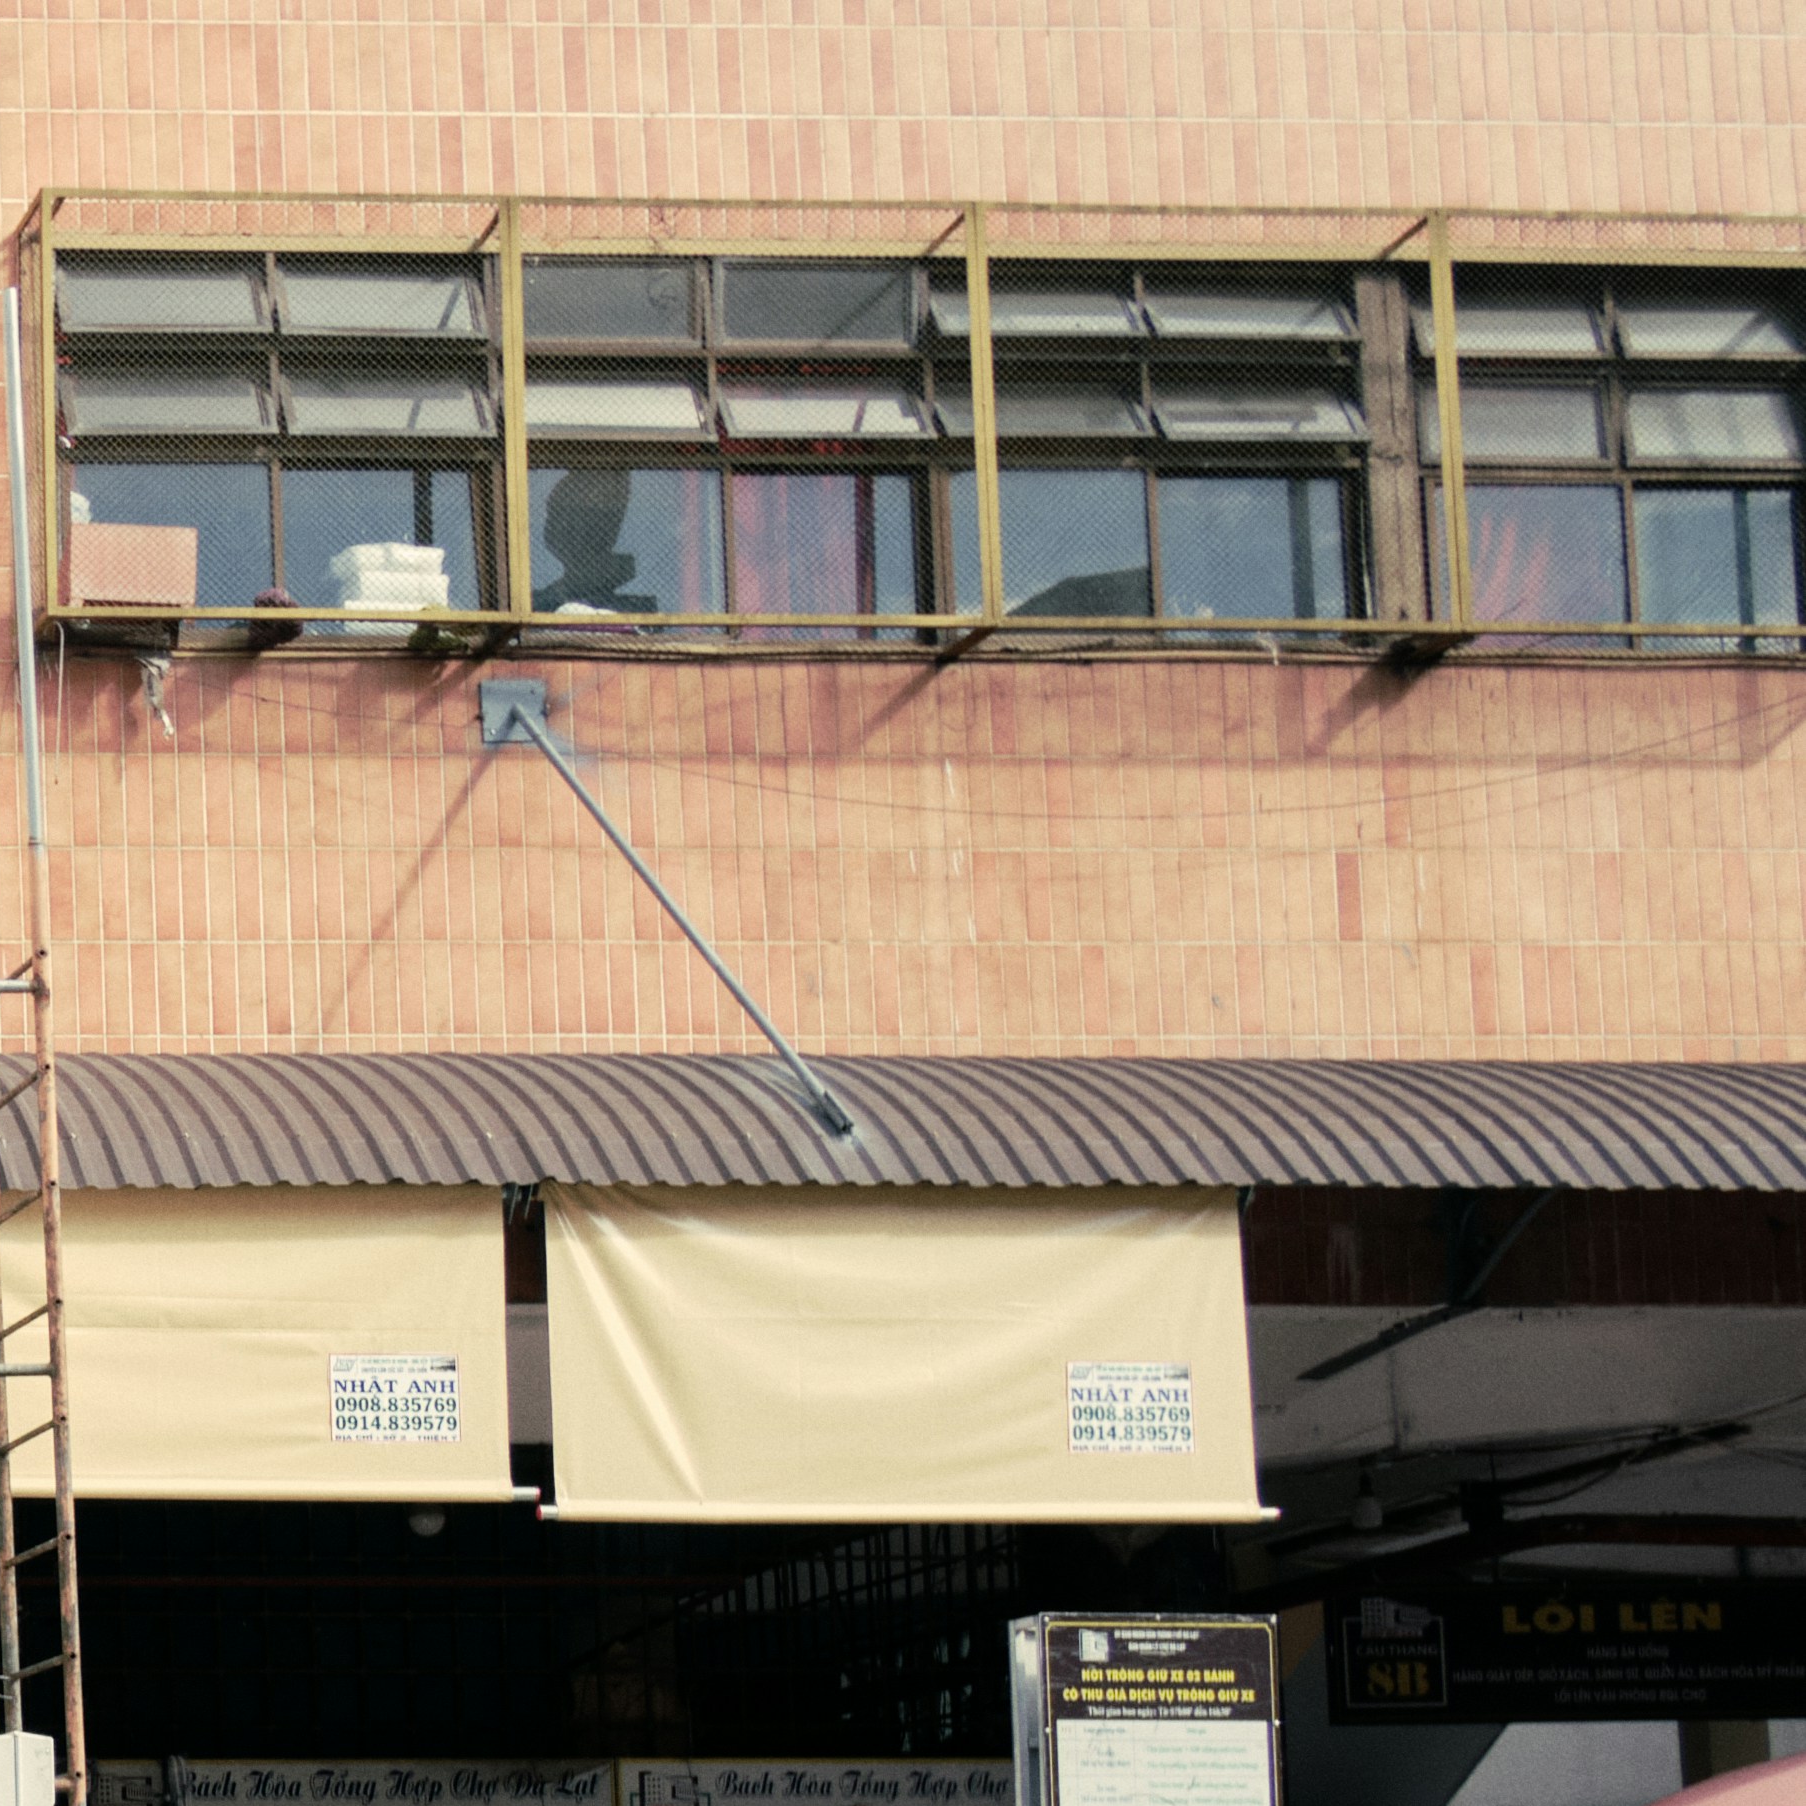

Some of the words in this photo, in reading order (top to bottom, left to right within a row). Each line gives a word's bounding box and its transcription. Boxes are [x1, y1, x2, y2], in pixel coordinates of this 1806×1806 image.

[408, 1379, 456, 1394] ANH
[1142, 1388, 1189, 1402] ANH
[334, 1397, 457, 1413] 0908.835769
[1072, 1406, 1191, 1422] 0908.835769
[335, 1415, 458, 1431] 0914.839579
[1072, 1425, 1192, 1441] 0914.839579
[1501, 1592, 1595, 1633] LỐI
[1619, 1593, 1722, 1632] LÊN
[1388, 1643, 1438, 1656] THANG
[1367, 1660, 1430, 1697] 8B
[1081, 1686, 1103, 1702] THU
